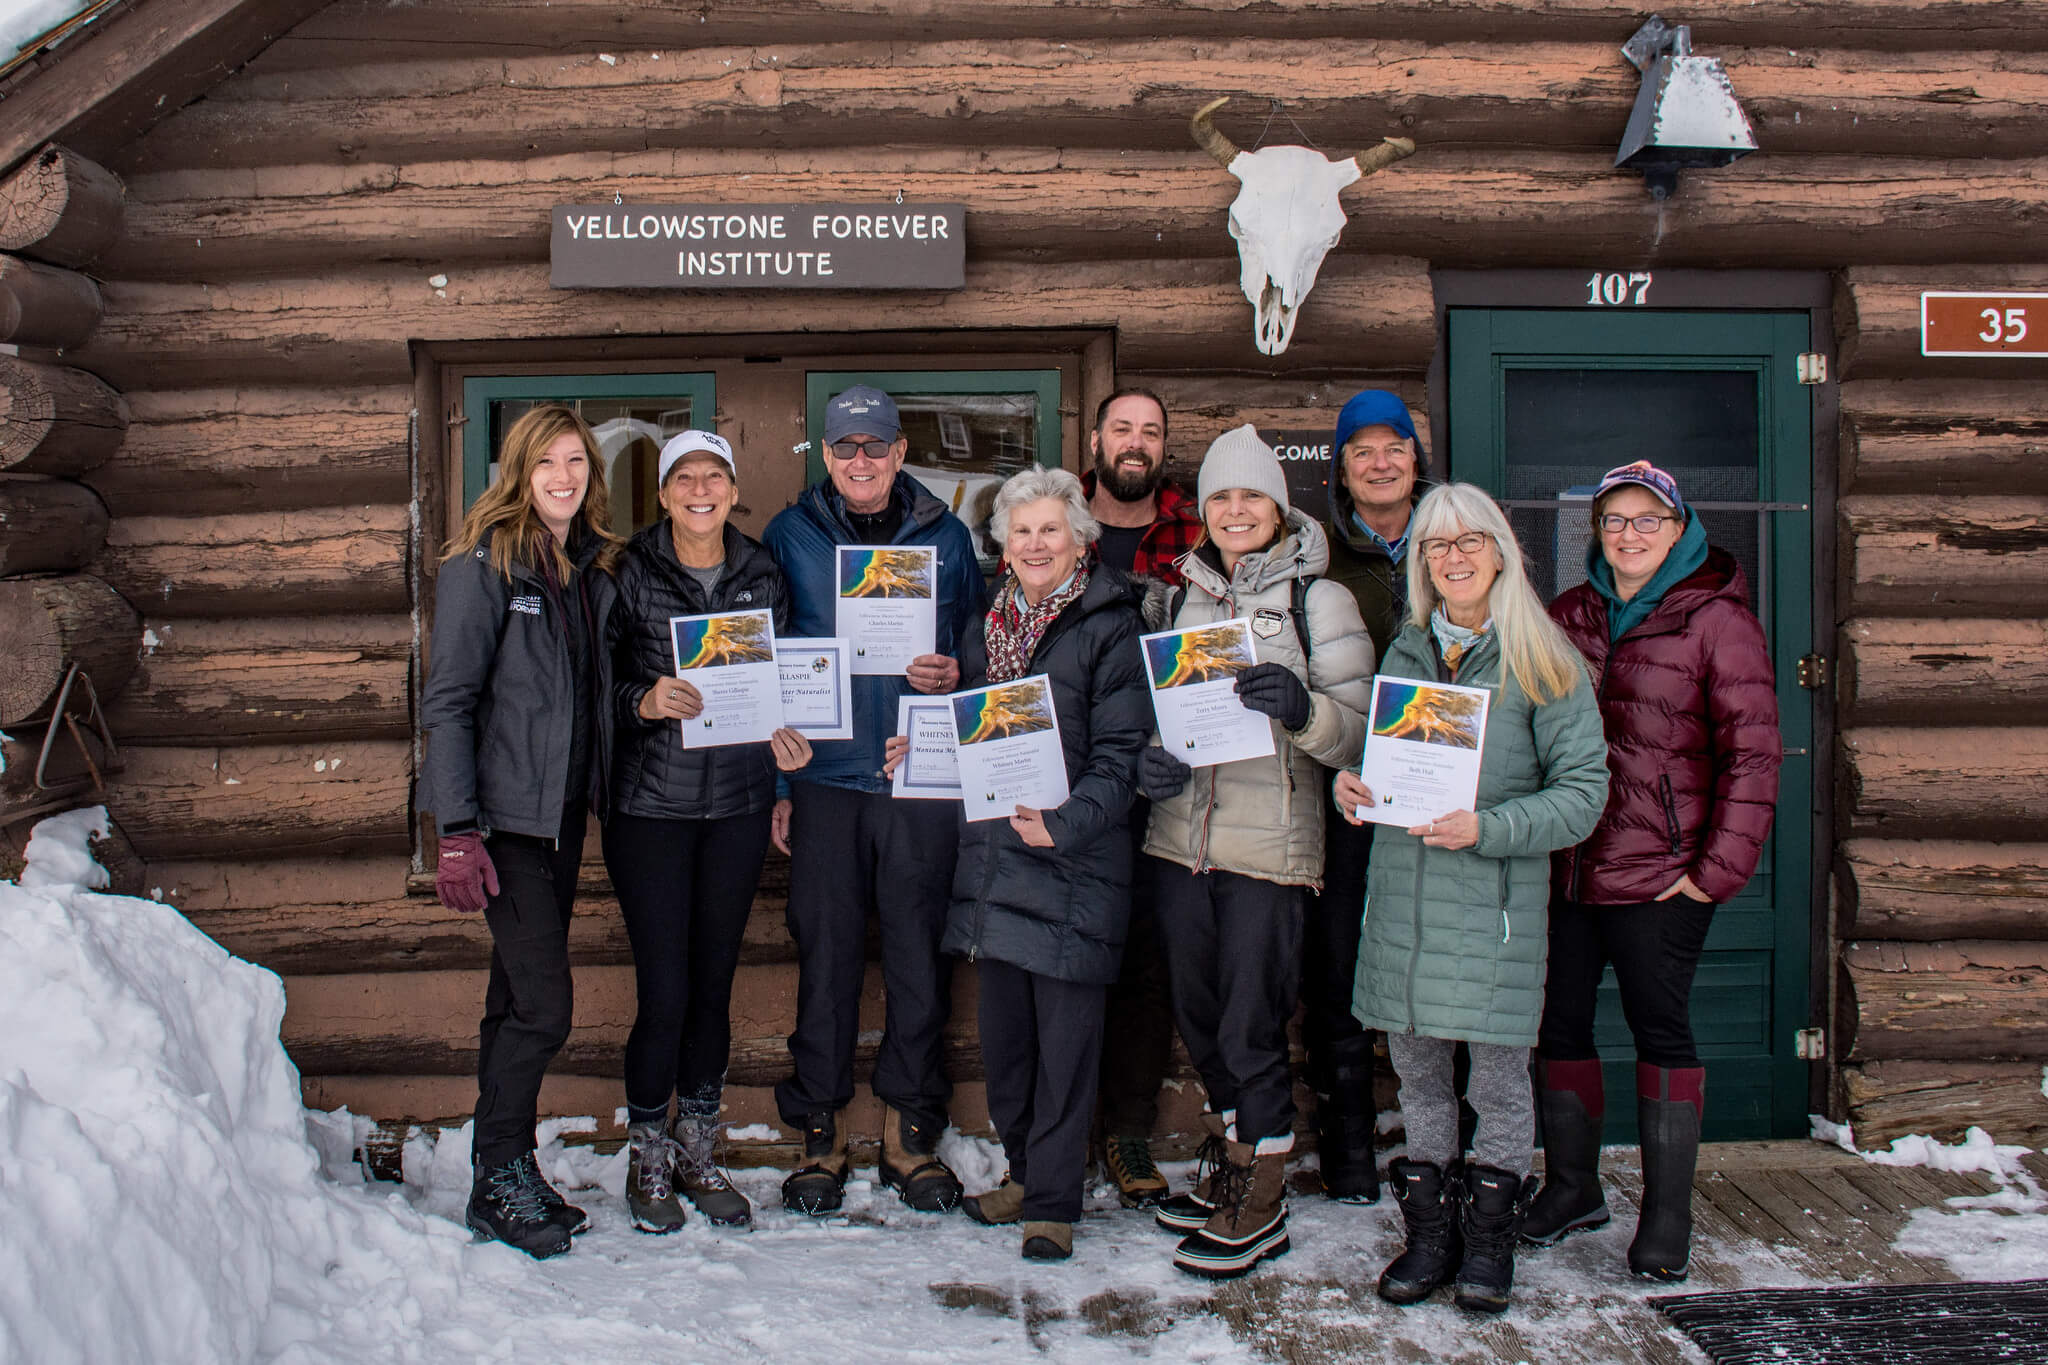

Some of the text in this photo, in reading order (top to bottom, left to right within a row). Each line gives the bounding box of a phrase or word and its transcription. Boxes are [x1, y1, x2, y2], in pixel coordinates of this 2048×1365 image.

[566, 215, 949, 239] YELLOWSTONE FOREVER
[678, 251, 834, 275] INSTITUTE
[1585, 272, 1653, 305] 107
[1979, 308, 2027, 343] 35
[1273, 445, 1332, 461] COME
[780, 673, 811, 681] ILLASPIE
[796, 687, 831, 696] Naturalist
[919, 731, 954, 739] WHITNEY
